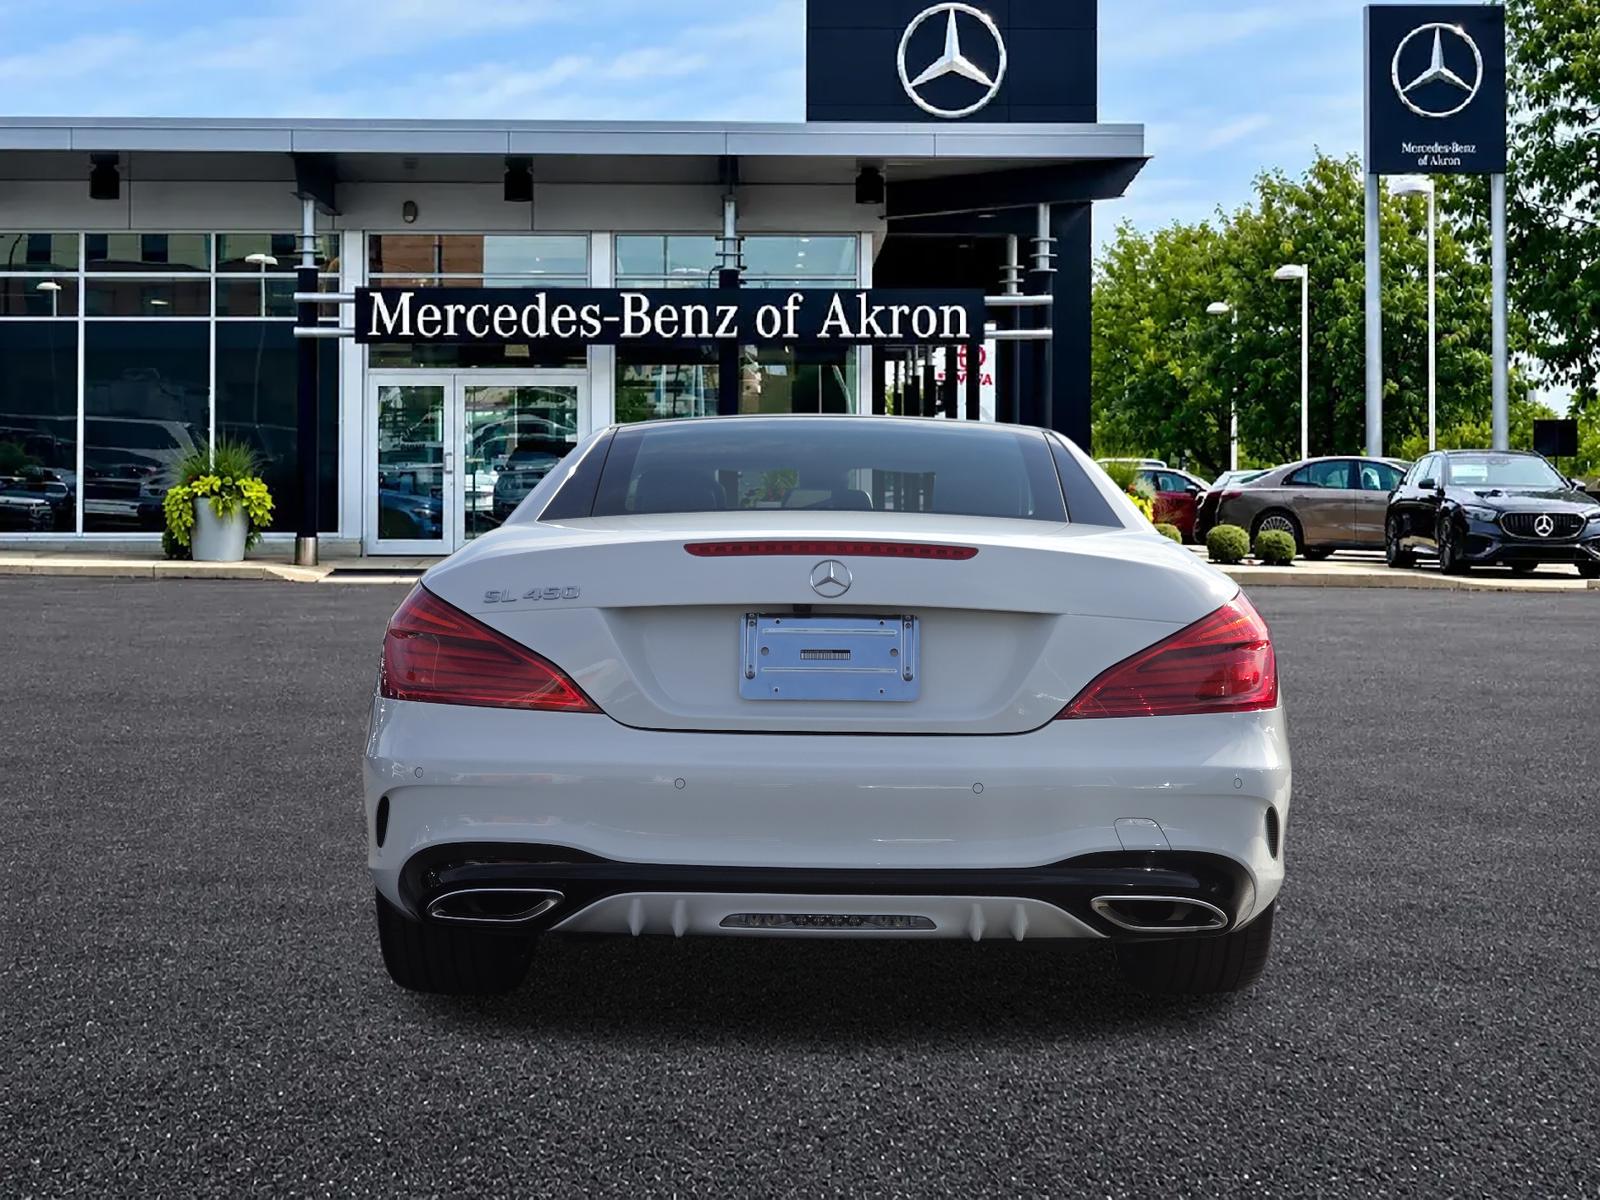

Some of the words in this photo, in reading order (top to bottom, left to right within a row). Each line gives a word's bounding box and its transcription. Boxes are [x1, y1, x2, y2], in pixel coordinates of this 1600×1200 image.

[1401, 142, 1476, 153] Mercedes-Benz
[1417, 154, 1428, 166] of
[1430, 154, 1461, 166] Akron
[367, 291, 738, 339] Mercedes-Benz
[755, 292, 803, 339] of
[816, 292, 970, 339] Akron
[483, 589, 518, 604] SL
[522, 585, 581, 601] 450
